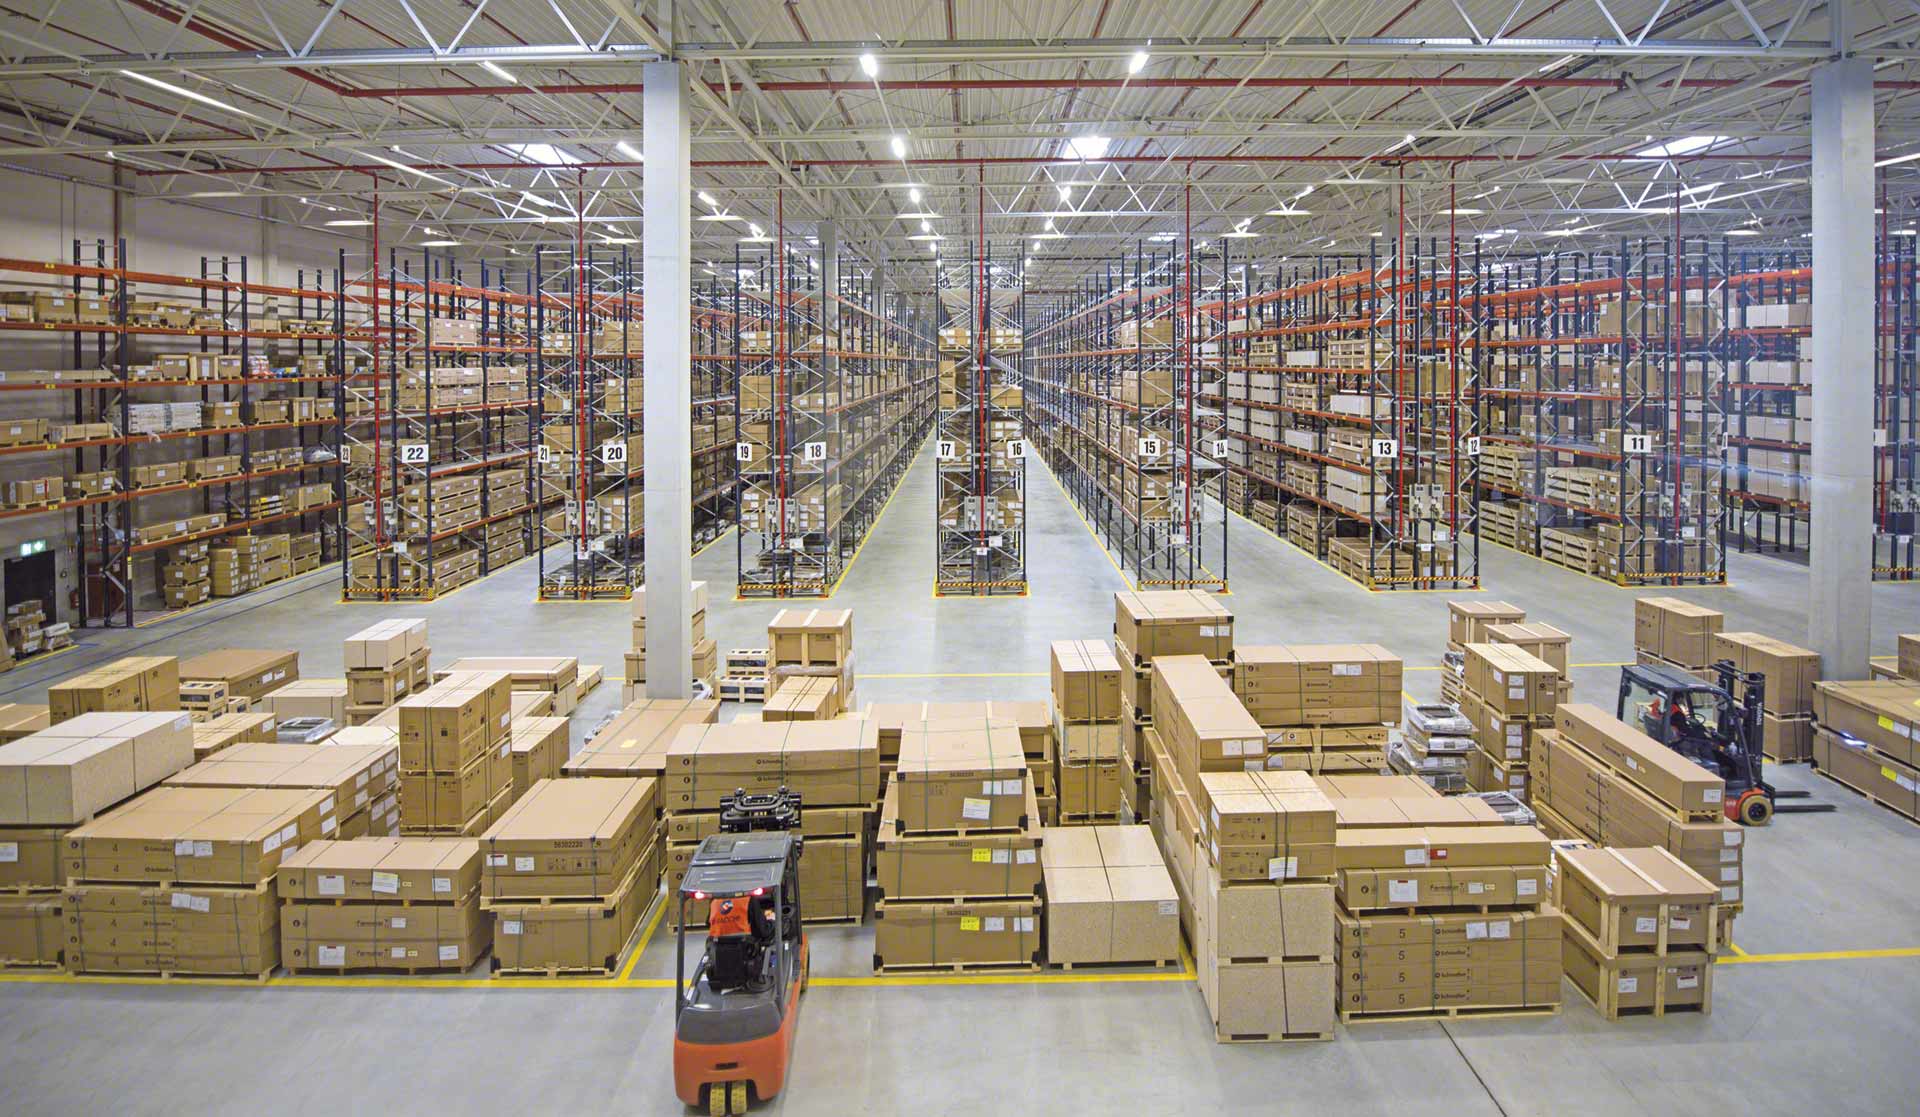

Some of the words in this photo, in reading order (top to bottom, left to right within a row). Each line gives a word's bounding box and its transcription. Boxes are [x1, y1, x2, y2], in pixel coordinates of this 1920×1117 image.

[940, 443, 951, 456] 17
[1012, 442, 1022, 456] 16
[1144, 441, 1156, 454] 15
[1216, 442, 1225, 456] 14
[1377, 442, 1392, 455] 13
[1470, 440, 1478, 453] 12
[1631, 437, 1644, 450] 11
[407, 447, 424, 460] 22
[540, 447, 548, 460] 21
[607, 446, 623, 460] 20
[740, 445, 749, 459] 19
[809, 444, 822, 458] 18
[1400, 928, 1406, 939] 5
[1399, 950, 1406, 961] 5
[1400, 972, 1406, 983] 5
[1399, 993, 1406, 1004] 5
